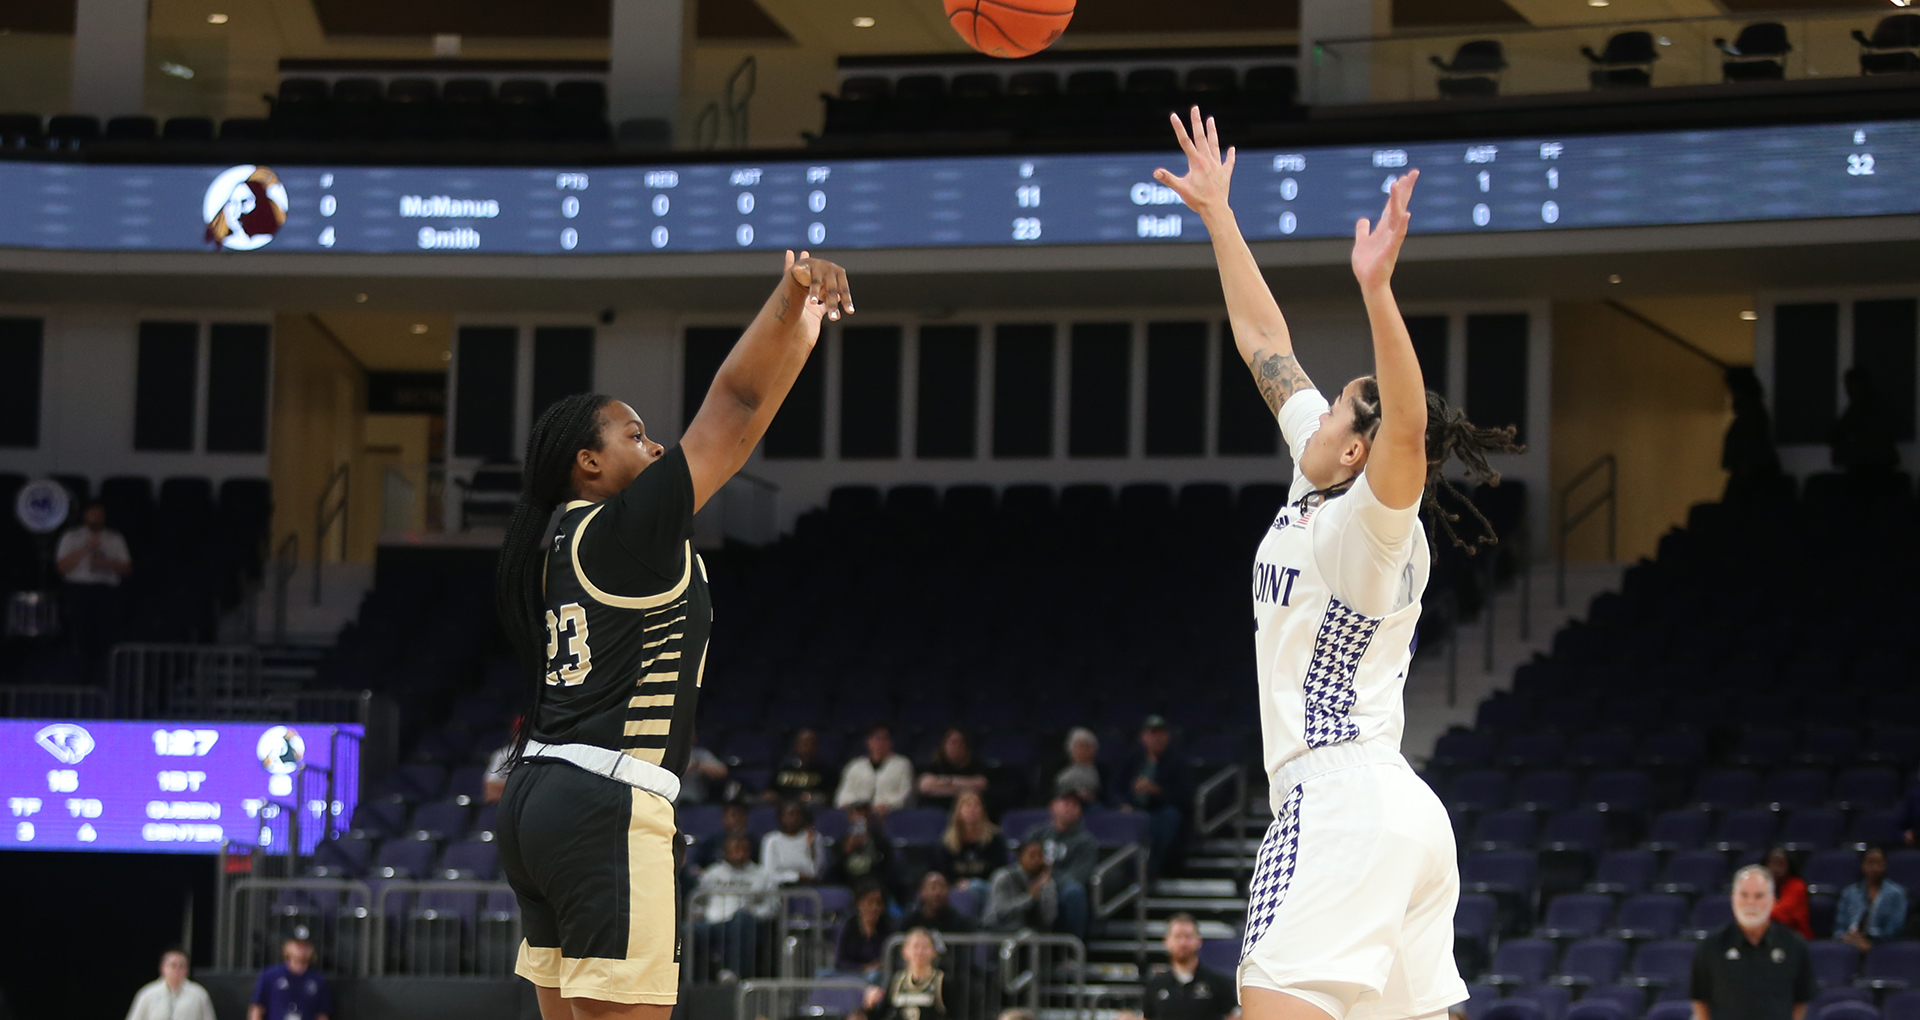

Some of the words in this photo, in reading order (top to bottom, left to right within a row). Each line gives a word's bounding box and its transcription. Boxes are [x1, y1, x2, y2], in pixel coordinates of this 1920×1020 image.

[807, 167, 829, 182] PF
[1847, 154, 1874, 175] 32
[1017, 186, 1040, 207] 11
[1280, 179, 1297, 200] 0
[1479, 172, 1489, 191] 1
[1548, 169, 1558, 188] 1
[320, 195, 336, 216] 0
[400, 196, 499, 217] McManus
[563, 197, 579, 218] 0
[653, 195, 669, 216] 0
[738, 193, 754, 214] 0
[809, 191, 826, 212] 0
[1013, 218, 1041, 240] 23
[1138, 215, 1181, 237] Hall
[1279, 212, 1296, 233] 0
[1473, 204, 1490, 226] 0
[1542, 201, 1558, 223] 0
[319, 227, 335, 247] 4
[419, 227, 480, 249] Smith
[561, 228, 578, 249] 0
[652, 227, 668, 247] 0
[737, 224, 753, 245] 0
[808, 223, 825, 244] 0
[1254, 562, 1300, 607] OINT
